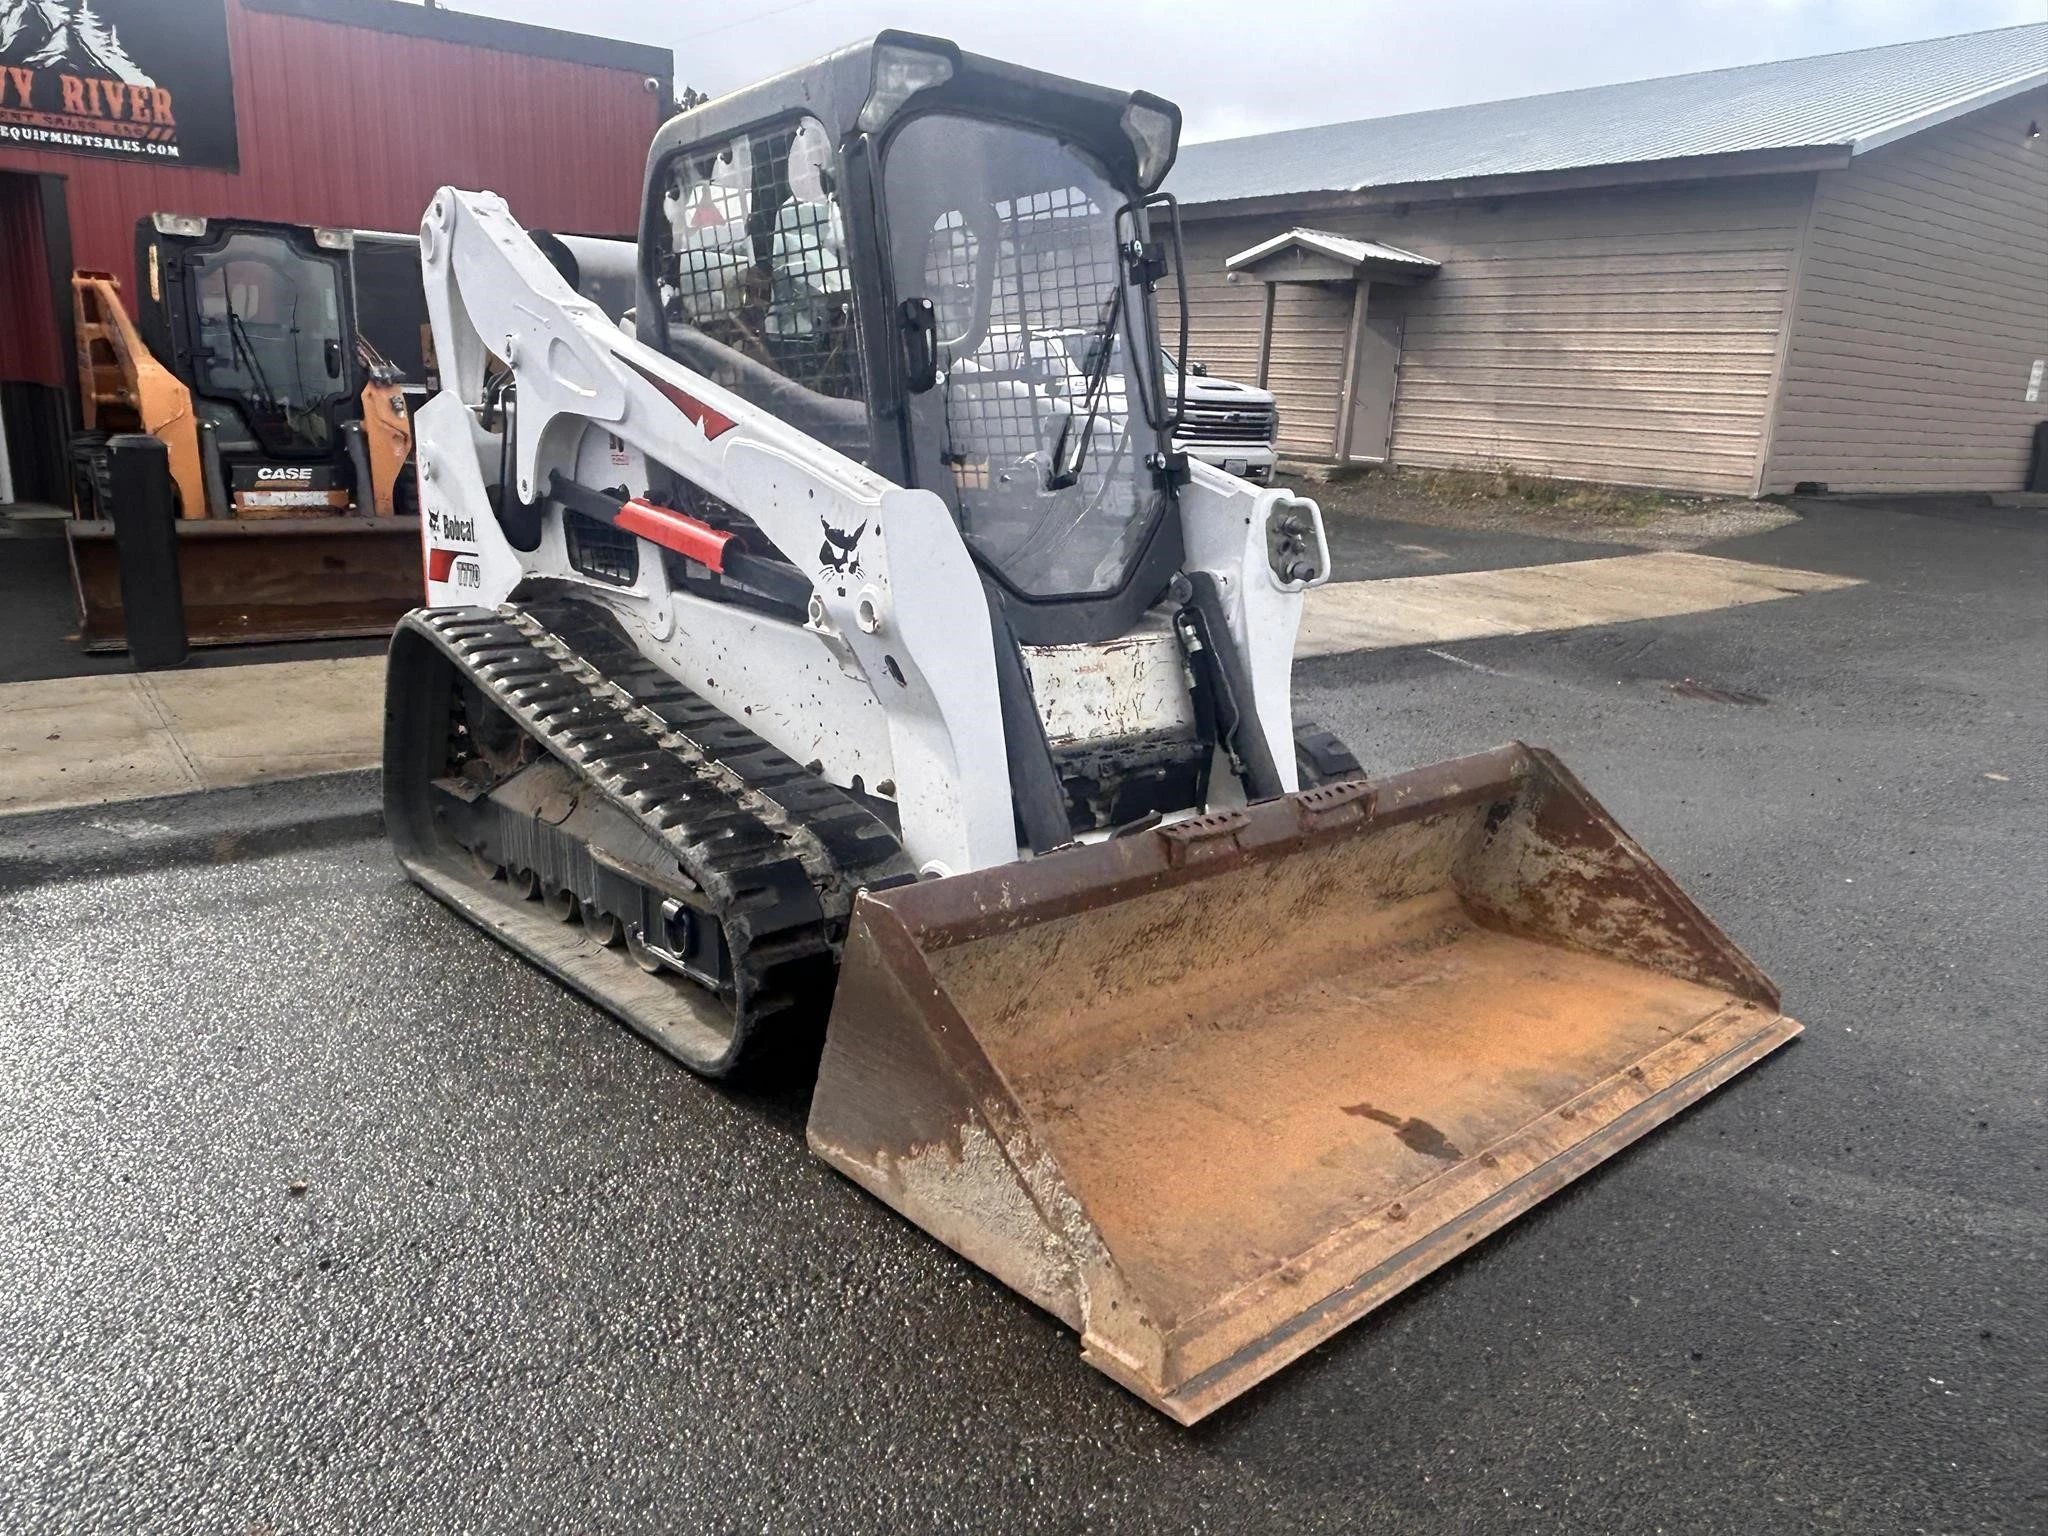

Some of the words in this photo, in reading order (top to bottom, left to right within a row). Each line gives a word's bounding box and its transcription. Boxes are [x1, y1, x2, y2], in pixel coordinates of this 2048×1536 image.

[0, 65, 33, 109] Y
[60, 73, 176, 127] RIVER
[0, 125, 179, 157] EQUIPMENTSALES.COM
[257, 467, 313, 480] CASE
[443, 514, 476, 543] Bobcat
[456, 561, 481, 589] T770
